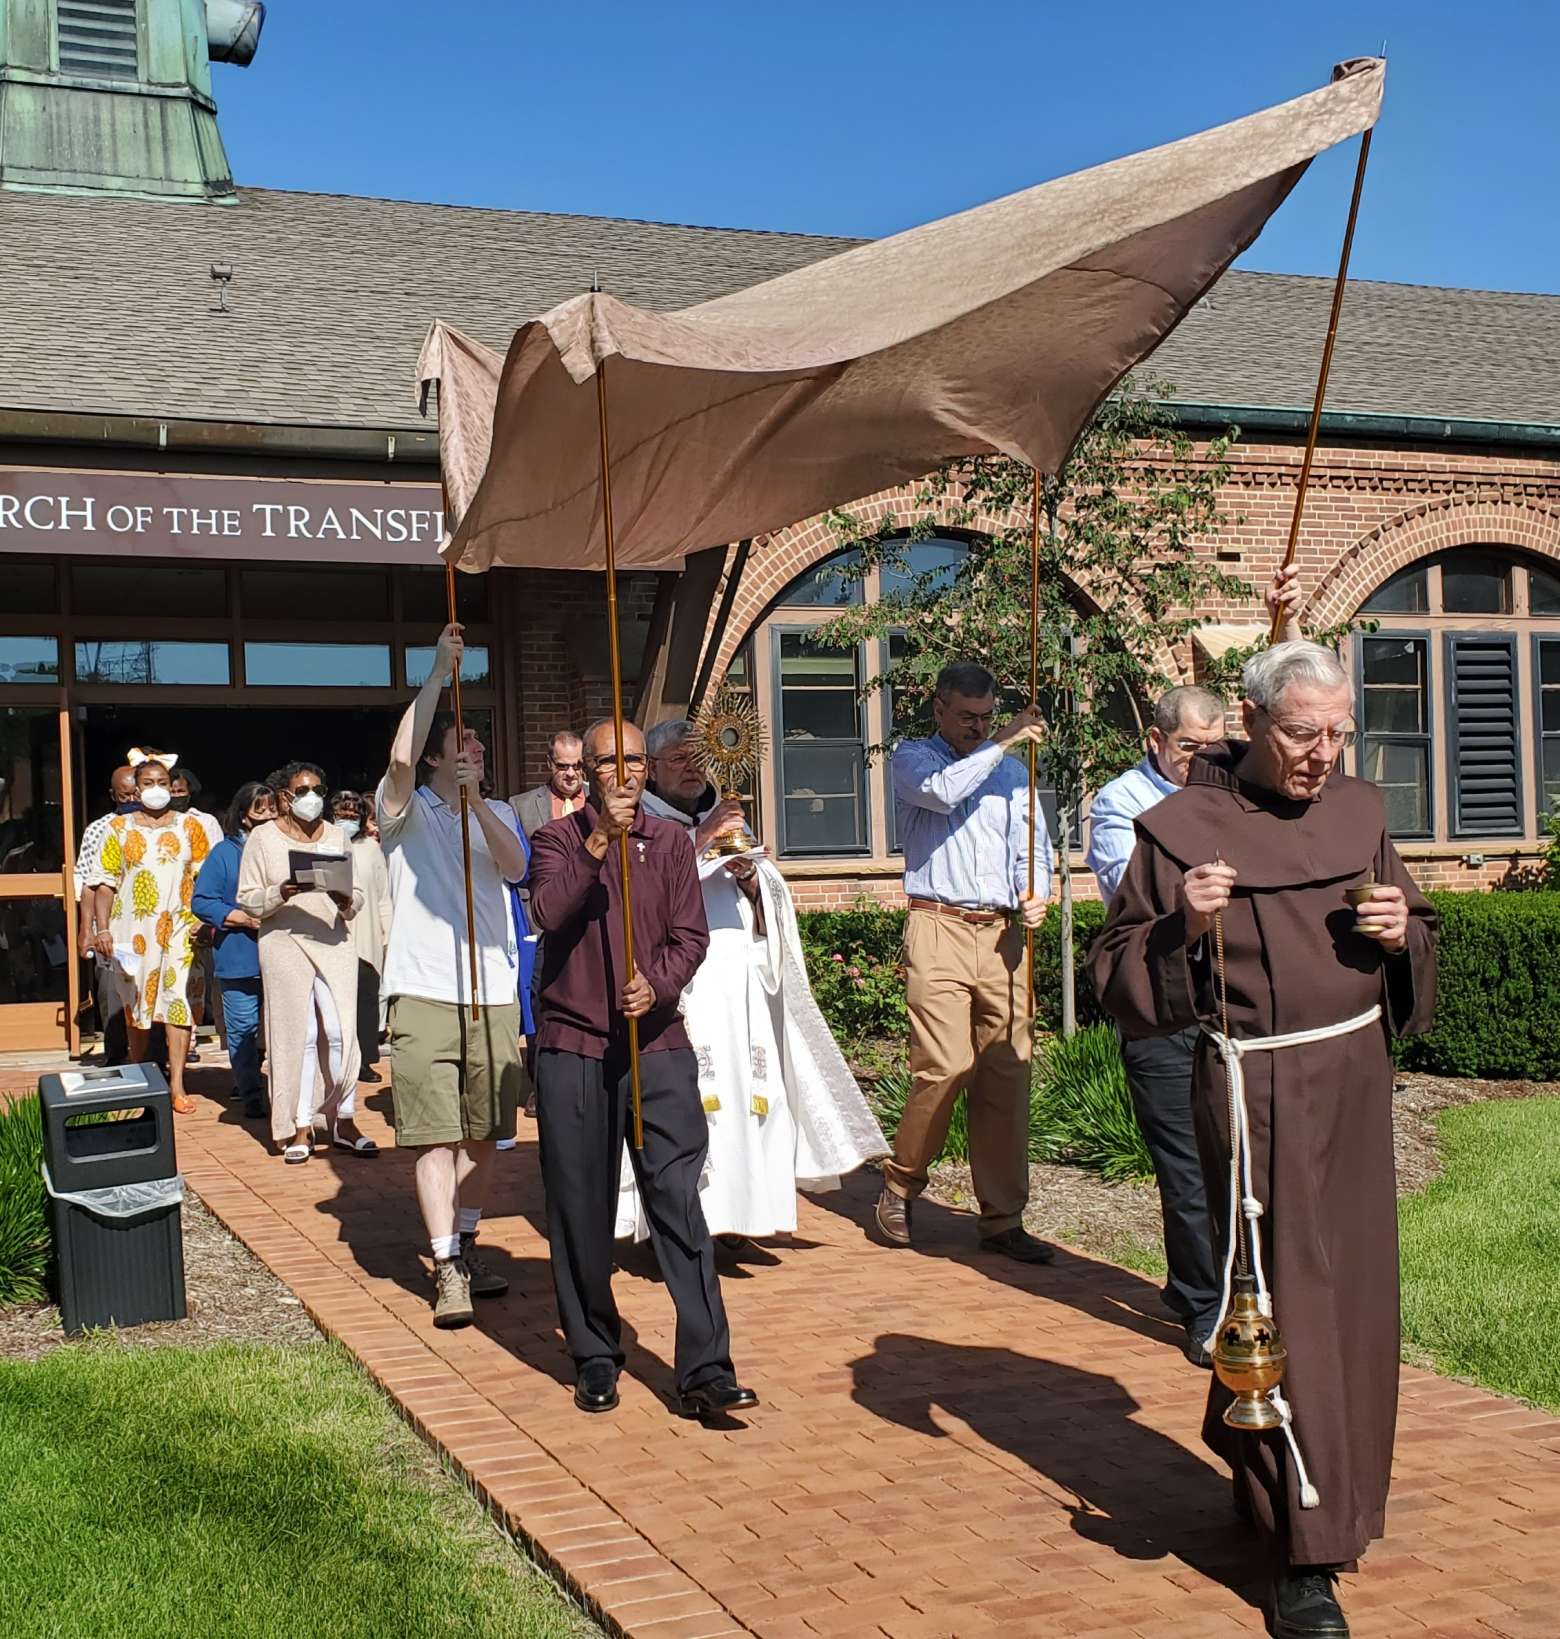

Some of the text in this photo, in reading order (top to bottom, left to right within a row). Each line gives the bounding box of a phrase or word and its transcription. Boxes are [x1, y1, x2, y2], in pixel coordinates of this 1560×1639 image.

[0, 494, 444, 542] RCH OF THE TRANSFI
